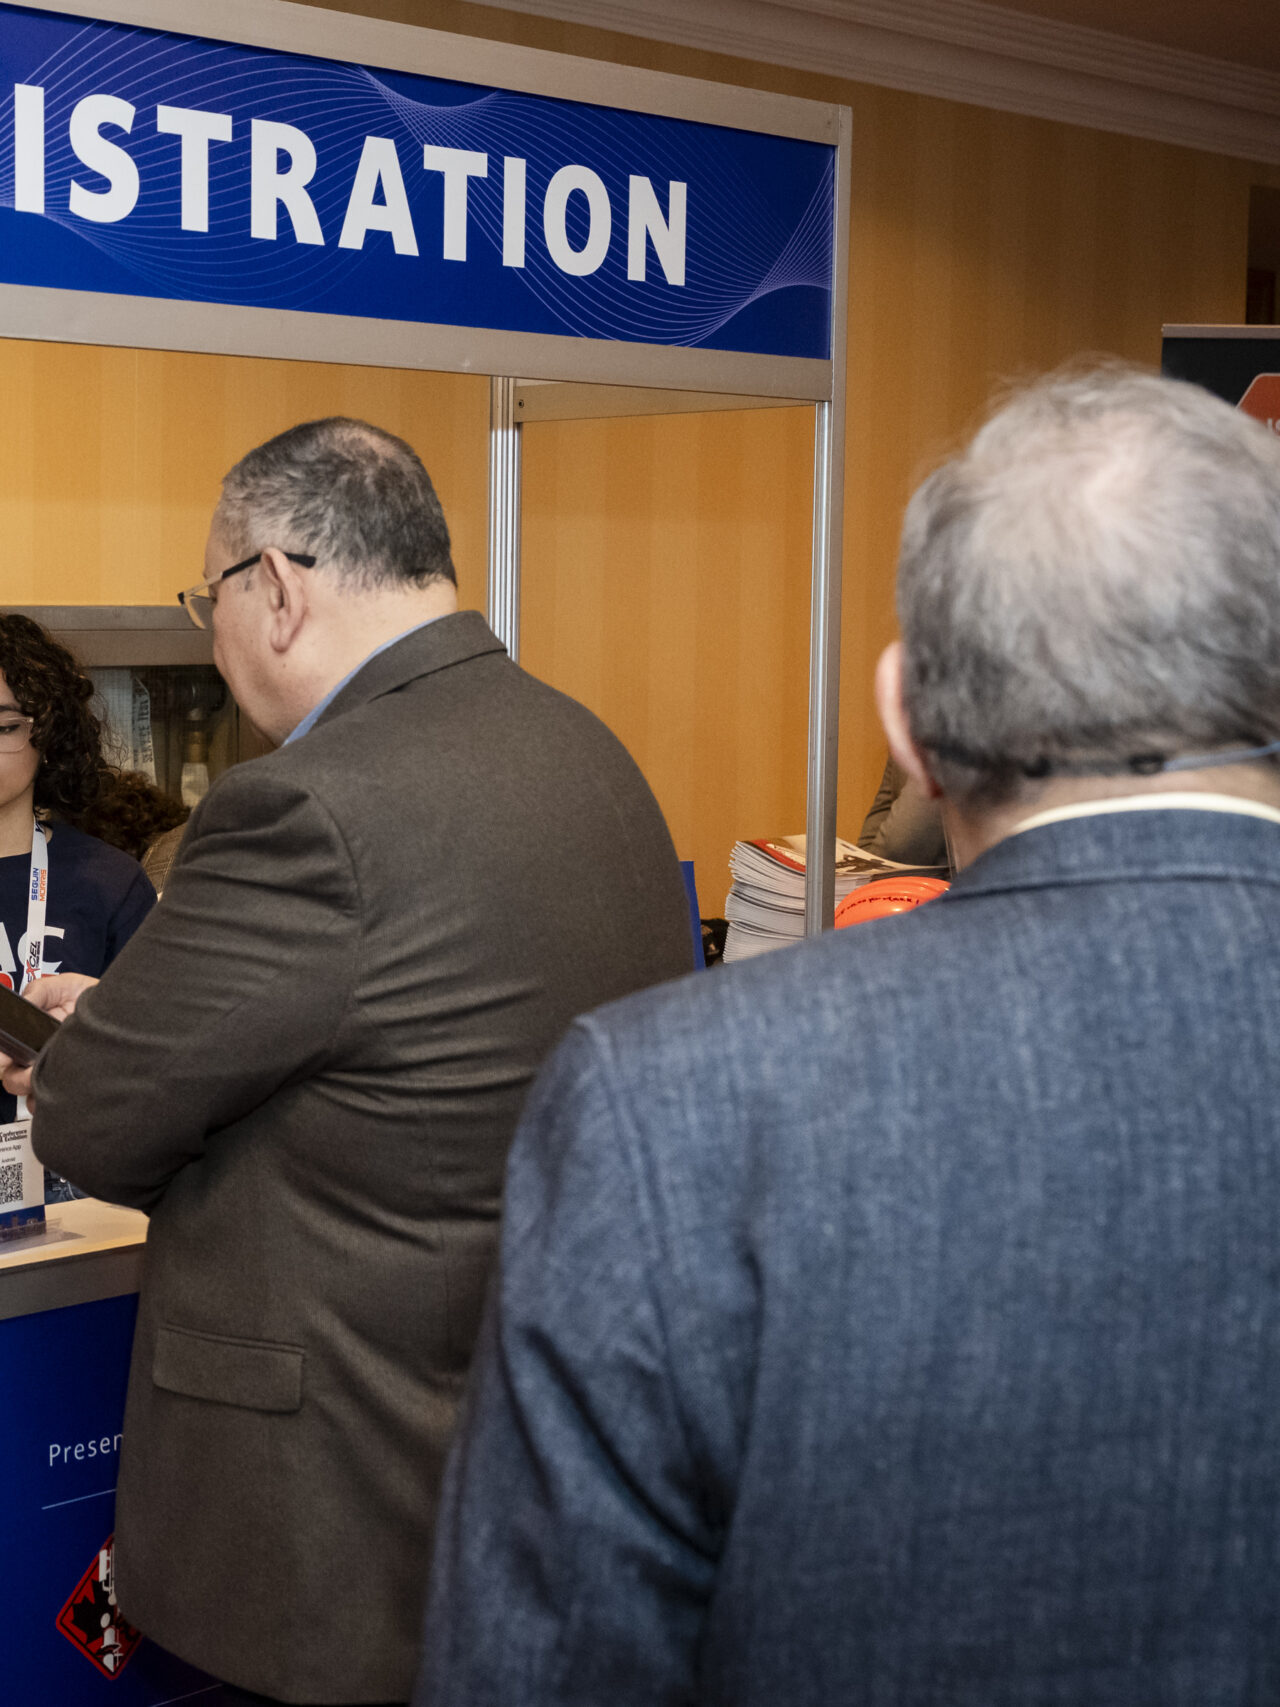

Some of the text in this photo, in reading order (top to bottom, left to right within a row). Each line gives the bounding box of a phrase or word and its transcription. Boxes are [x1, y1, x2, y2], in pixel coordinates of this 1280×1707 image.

[31, 867, 39, 901] SEGUIN
[39, 869, 47, 902] MORRIS
[12, 1144, 22, 1152] App
